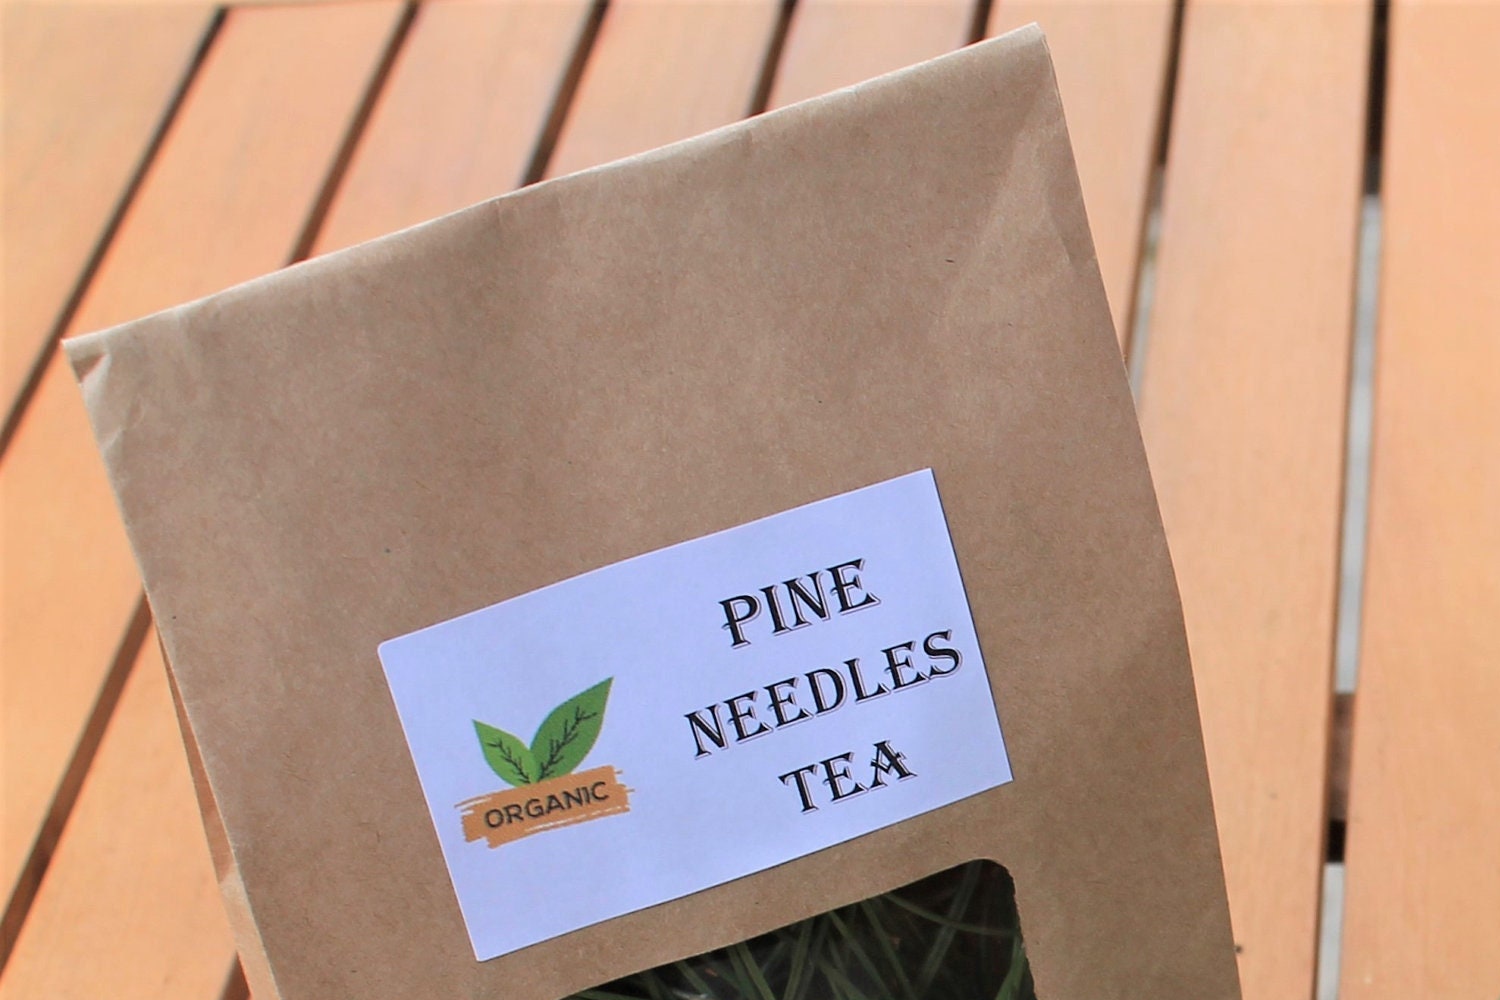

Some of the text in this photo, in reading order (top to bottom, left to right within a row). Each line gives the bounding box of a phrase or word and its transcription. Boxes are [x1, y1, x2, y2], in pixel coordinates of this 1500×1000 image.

[718, 557, 880, 648] PINE
[684, 629, 964, 760] NEEDLES
[483, 780, 611, 830] ORGANIC
[778, 738, 918, 814] TEA
